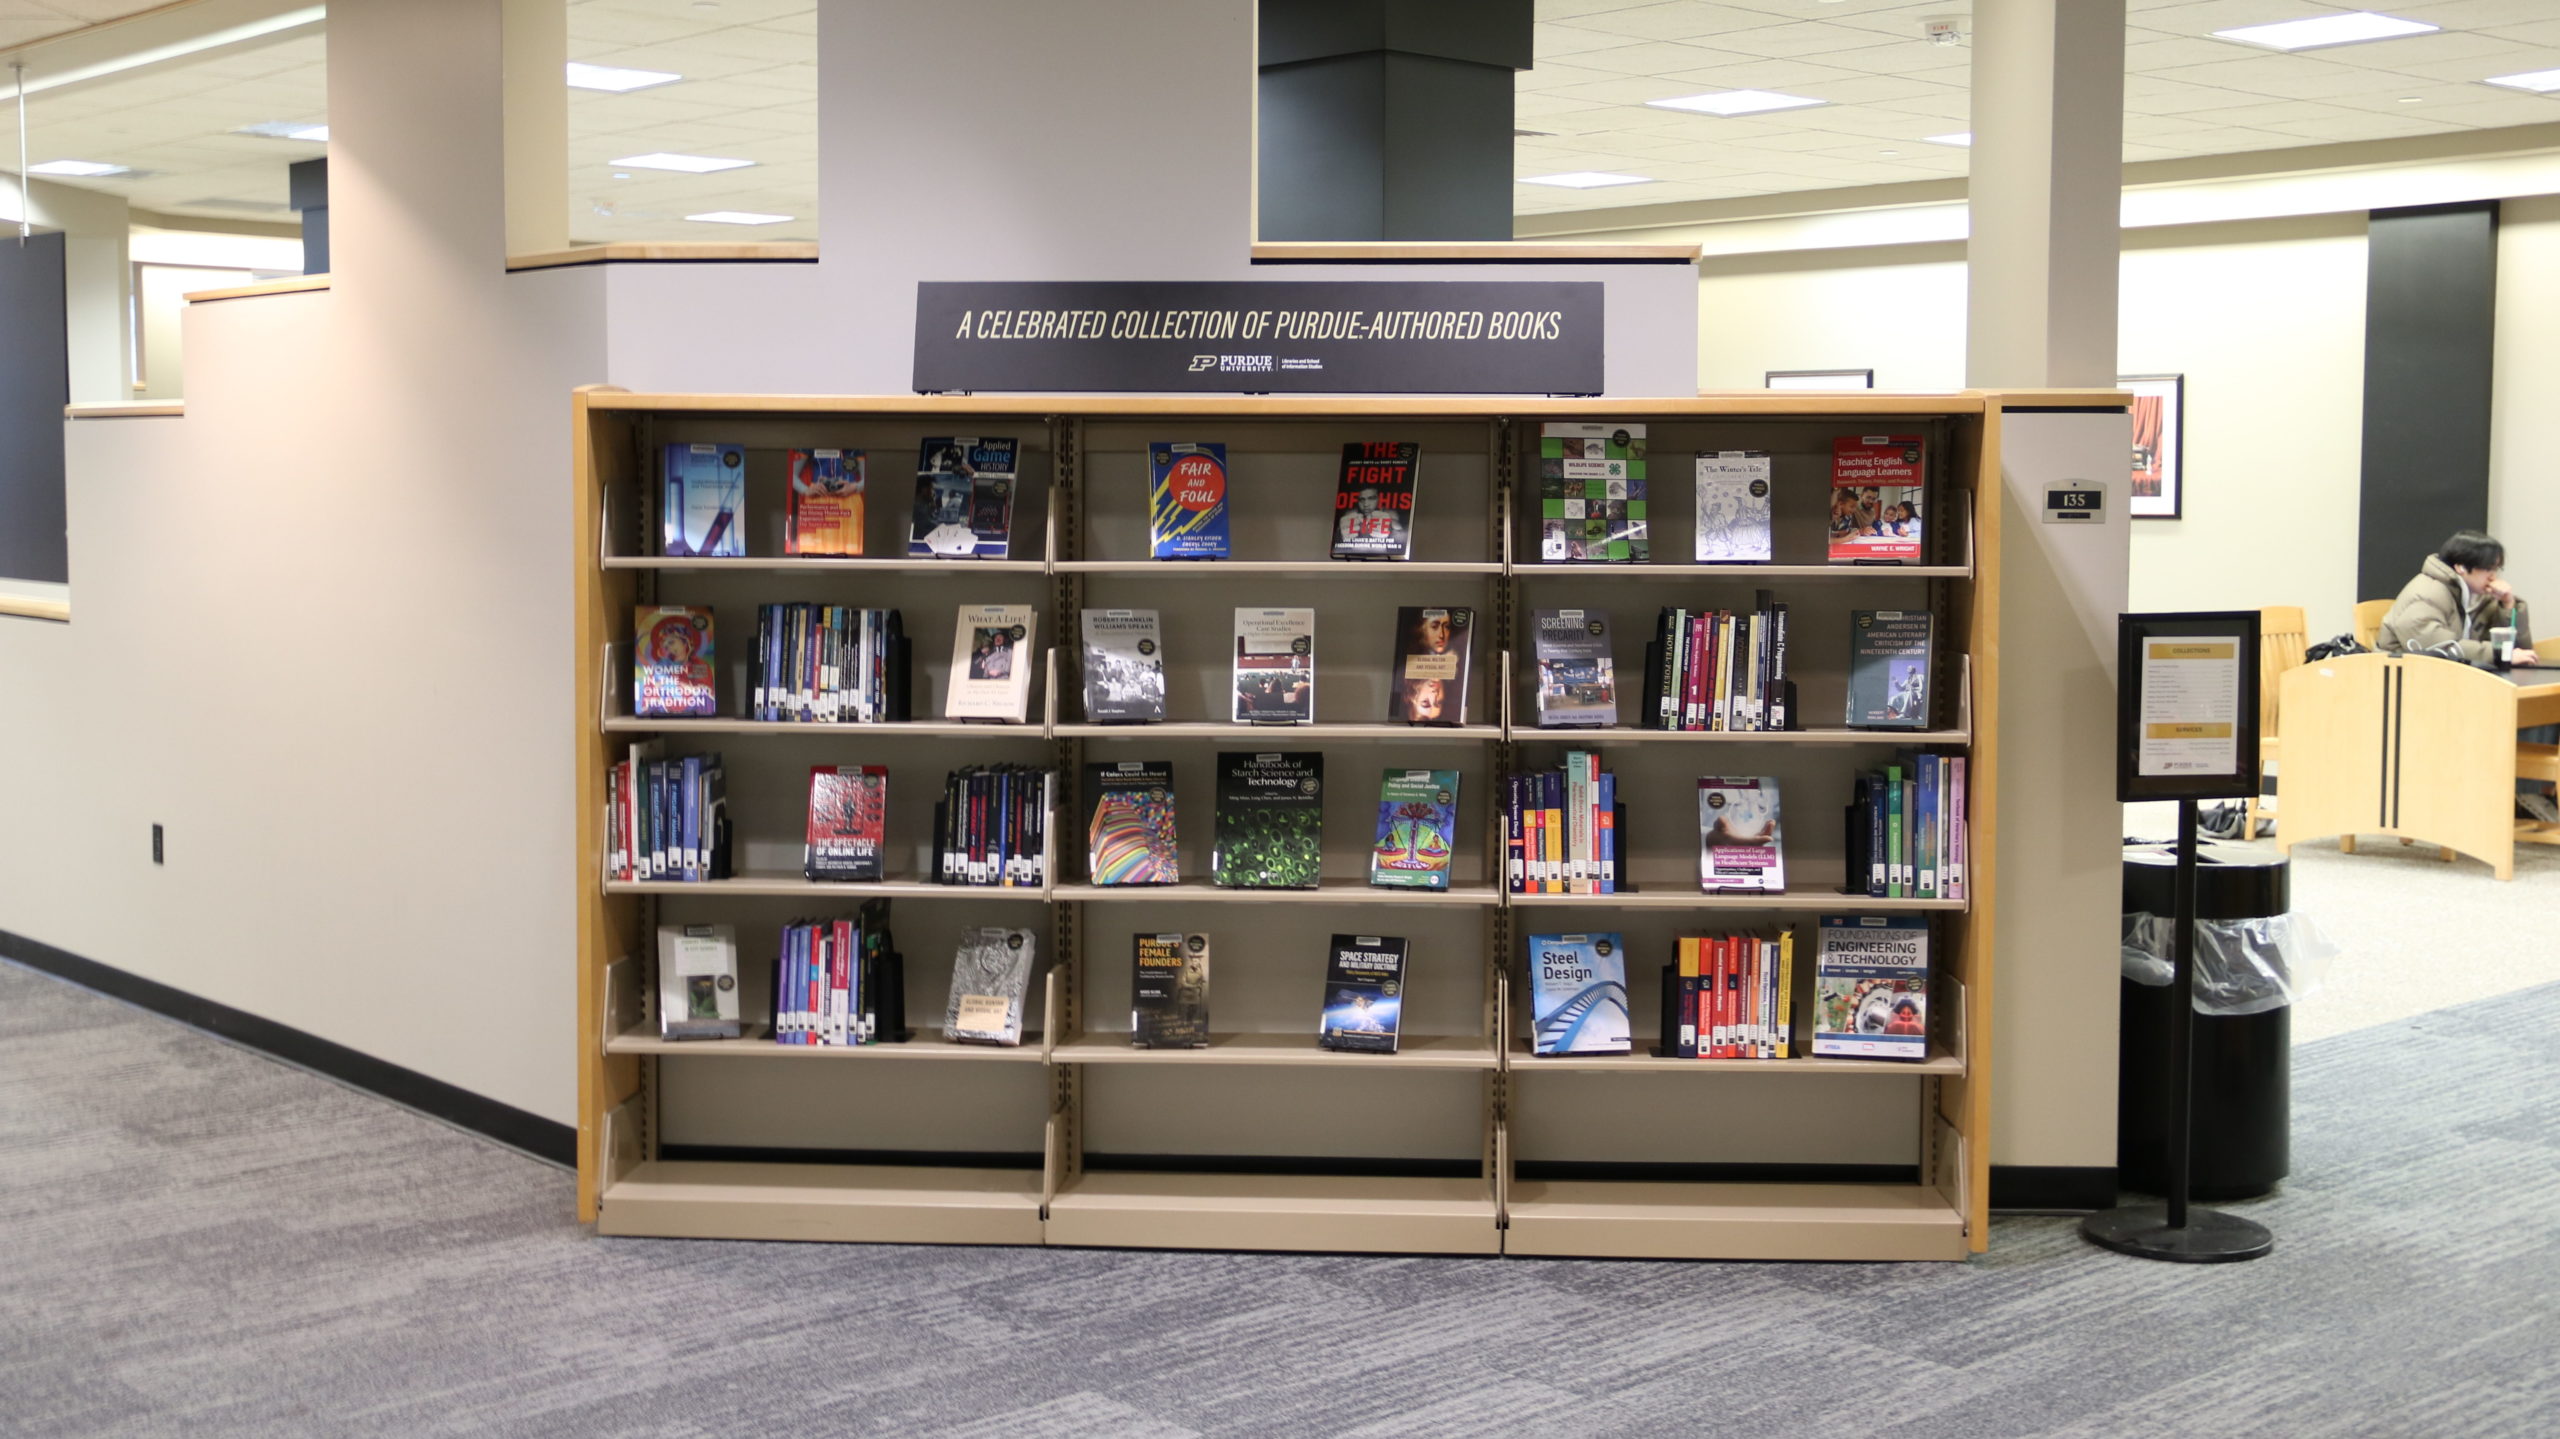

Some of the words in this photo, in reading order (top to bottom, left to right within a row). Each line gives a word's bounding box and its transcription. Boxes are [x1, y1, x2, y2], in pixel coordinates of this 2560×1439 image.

[956, 311, 973, 340] A
[976, 311, 1105, 340] CELEBRATED
[1111, 311, 1237, 340] COLLECTION
[1243, 311, 1272, 340] OF
[1275, 311, 1483, 340] PURDUE-AUTHORED
[1488, 311, 1561, 340] BOOKS
[1220, 356, 1272, 366] PURDUE
[984, 441, 1012, 451] Applied
[1362, 442, 1399, 458] THE
[973, 448, 1010, 463] Game
[1838, 458, 1872, 467] Teaching
[1874, 457, 1902, 466] English
[980, 463, 1009, 472] HISTORY
[1180, 462, 1212, 476] FAIR
[1346, 466, 1408, 484] FIGHT
[1838, 468, 1876, 478] Language
[1878, 468, 1912, 476] Learners
[1188, 479, 1206, 487] AND
[1180, 490, 1216, 503] FOUL
[1336, 492, 1360, 509] OF
[1378, 492, 1413, 510] HIS
[2064, 494, 2086, 506] 135
[1348, 518, 1392, 534] LIFE
[1542, 618, 1584, 629] SCREENING
[1542, 629, 1584, 640] PRECARITY
[643, 665, 688, 675] WOMEN
[644, 676, 655, 685] IN
[658, 676, 680, 685] THE
[644, 686, 709, 696] ORTHODOX
[644, 697, 706, 707] TRADITION
[1243, 760, 1291, 768] Handbook
[1232, 768, 1260, 777] Starch
[1261, 768, 1294, 777] Science
[1296, 768, 1314, 776] and
[1248, 778, 1298, 788] Technology
[816, 838, 832, 847] THE
[834, 838, 876, 847] SPECTACLE
[816, 848, 826, 856] OF
[828, 848, 856, 856] ONLINE
[856, 848, 873, 856] LIFE
[1828, 930, 1900, 940] FOUNDATIONS
[1902, 931, 1917, 941] OF
[1139, 948, 1172, 957] FEMALE
[1828, 942, 1916, 954] ENGINEERING
[1139, 958, 1183, 967] FOUNDERS
[1340, 951, 1363, 962] SPACE
[1363, 952, 1399, 964] STRATEGY
[1542, 951, 1579, 964] Steel
[1827, 954, 1835, 963] &
[1838, 954, 1917, 966] TECHNOLOGY
[1374, 962, 1398, 971] DOCTRINE
[1544, 966, 1592, 982] Design
